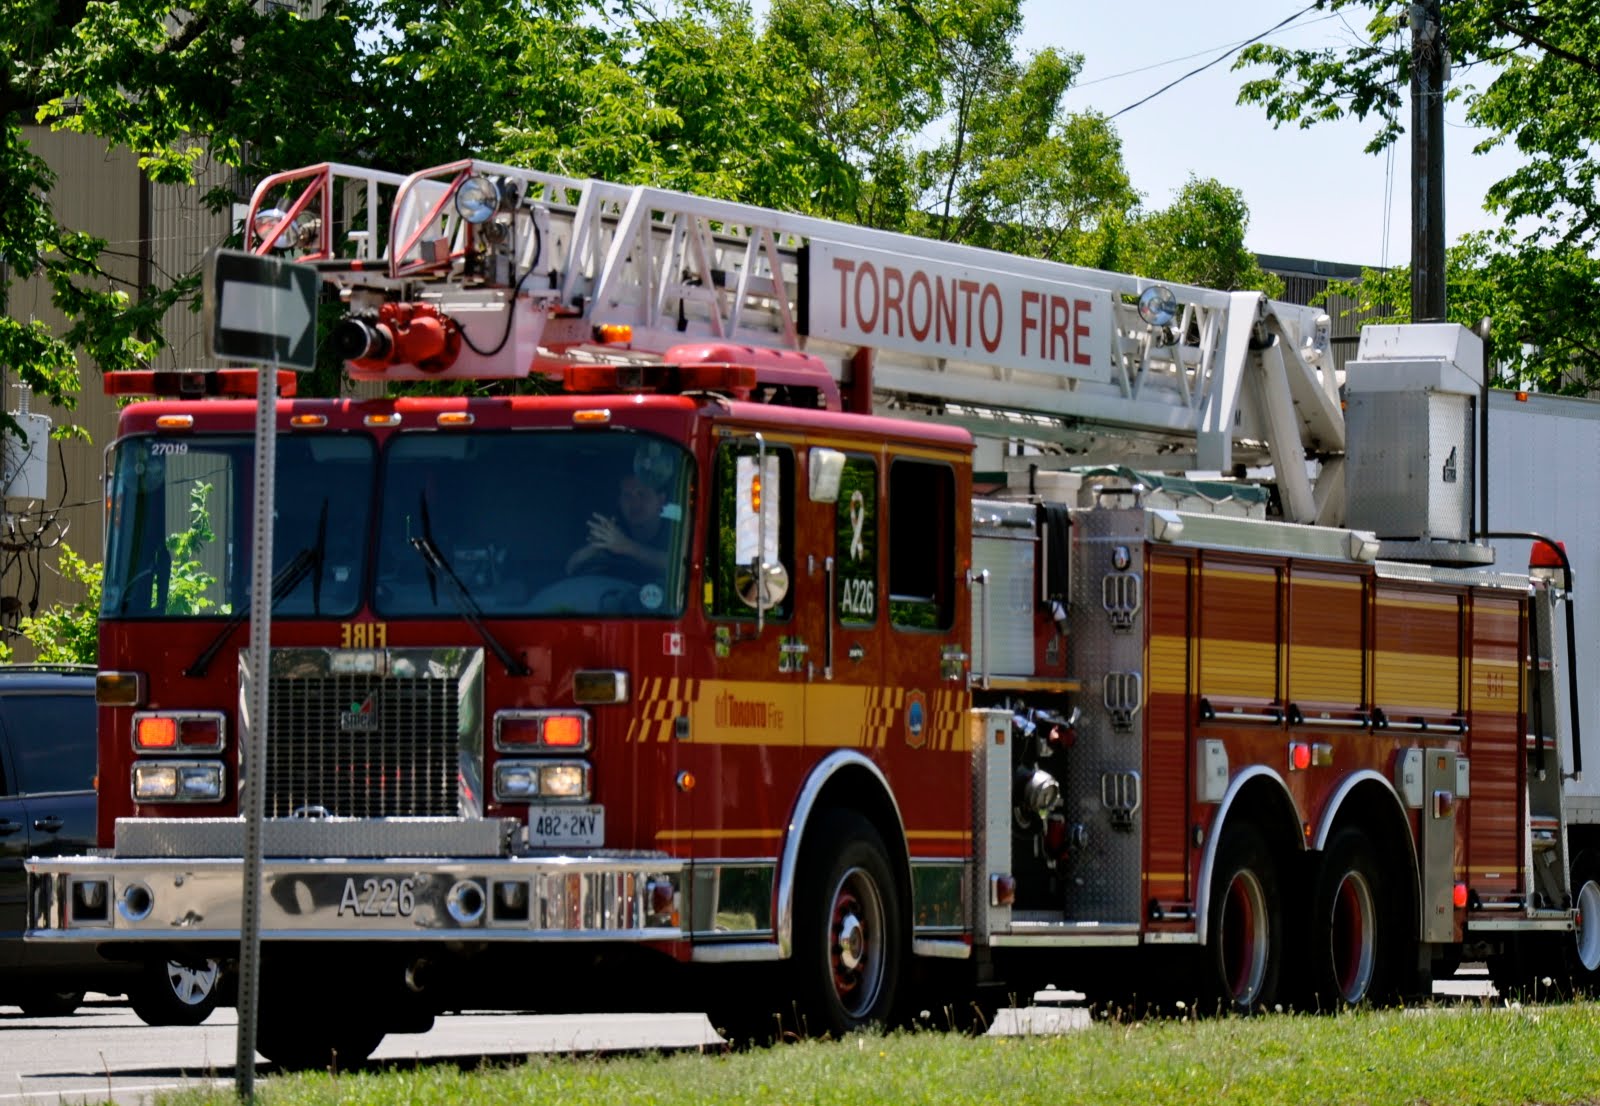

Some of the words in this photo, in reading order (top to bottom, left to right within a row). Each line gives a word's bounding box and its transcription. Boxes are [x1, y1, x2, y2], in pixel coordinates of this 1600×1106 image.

[833, 257, 1003, 353] TORONTO
[1020, 289, 1092, 366] FIRE
[151, 443, 188, 456] 27019
[841, 578, 874, 614] A226
[338, 877, 415, 917] A226
